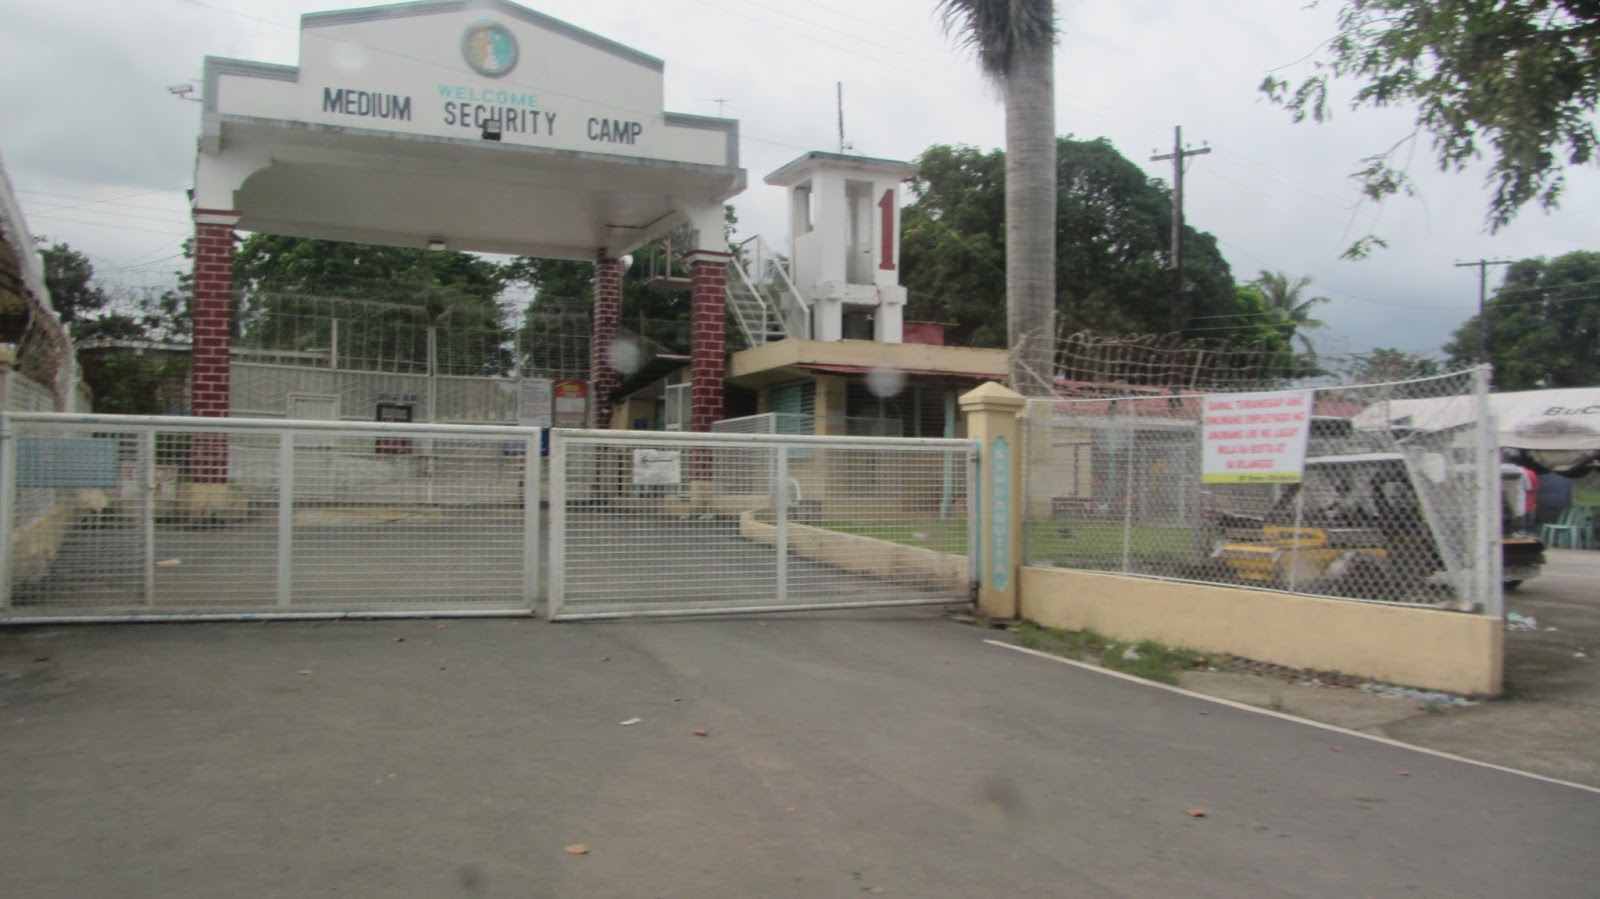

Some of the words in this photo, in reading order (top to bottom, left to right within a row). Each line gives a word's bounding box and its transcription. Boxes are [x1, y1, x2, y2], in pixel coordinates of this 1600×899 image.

[322, 86, 412, 122] MEDIUM
[444, 101, 557, 136] SECURITY
[587, 117, 643, 145] CAMP
[438, 83, 539, 107] WELCOME
[878, 188, 896, 271] 1
